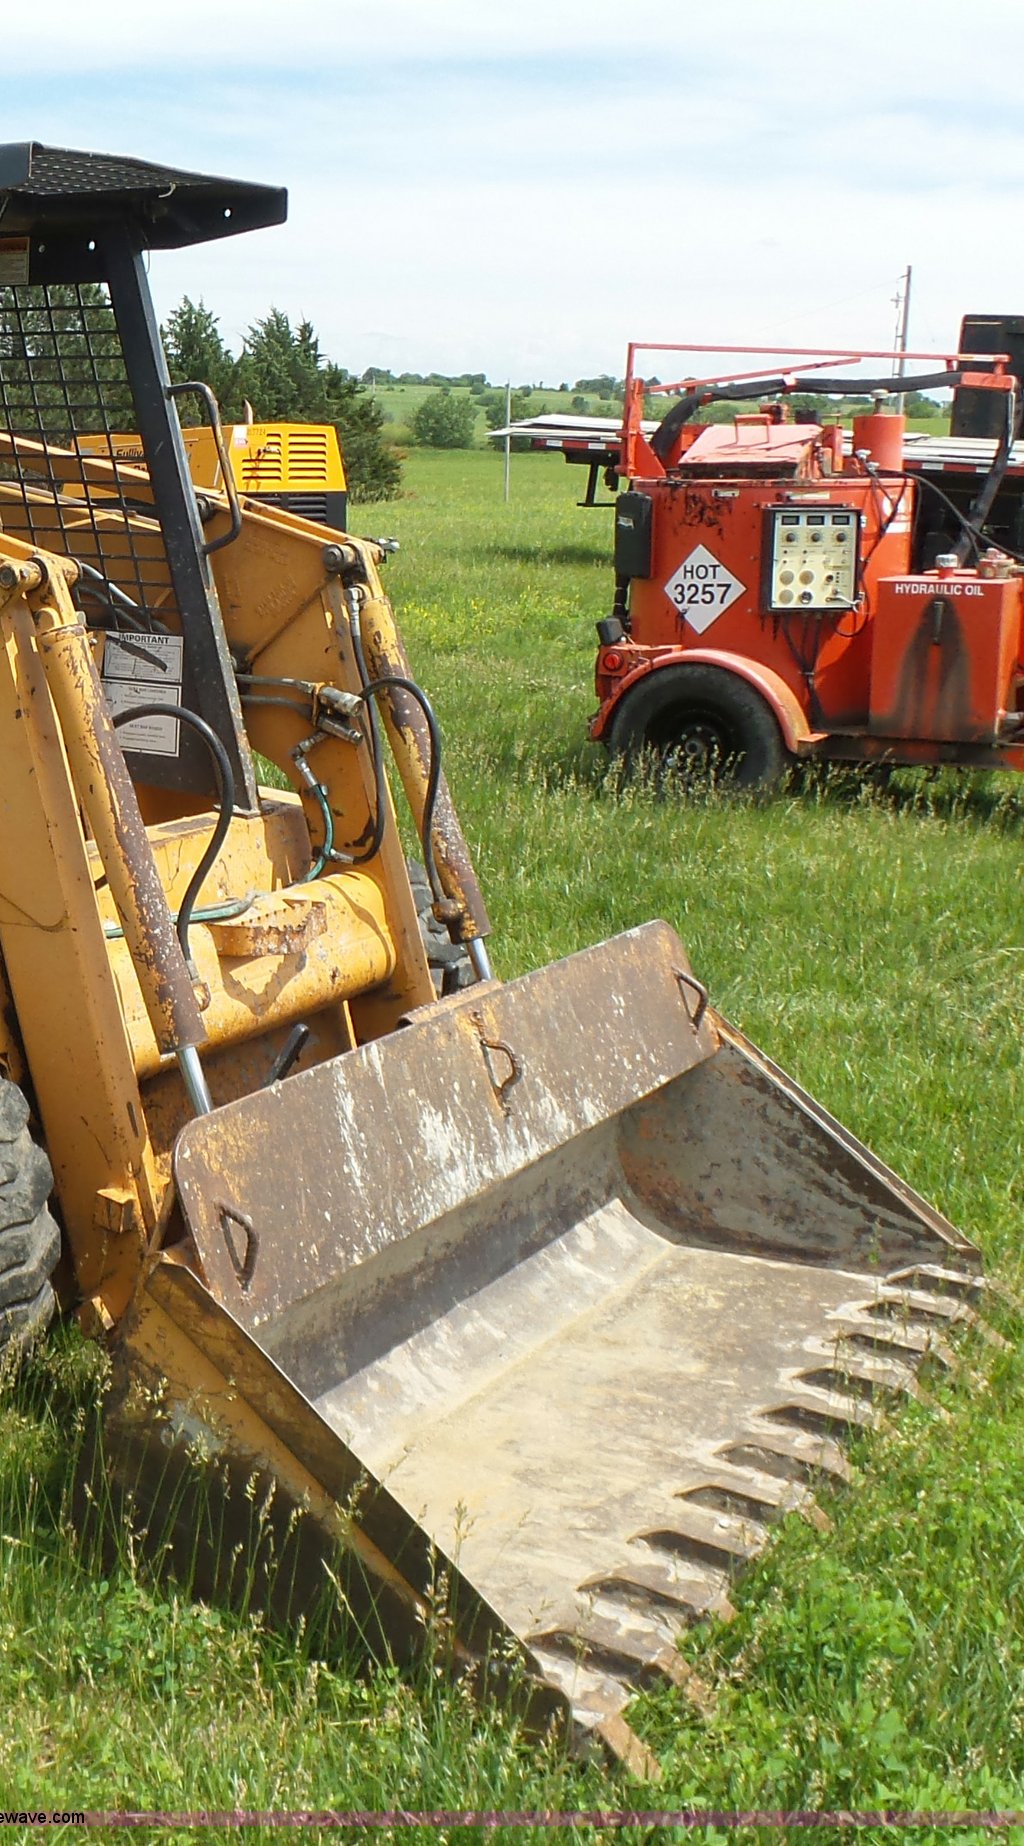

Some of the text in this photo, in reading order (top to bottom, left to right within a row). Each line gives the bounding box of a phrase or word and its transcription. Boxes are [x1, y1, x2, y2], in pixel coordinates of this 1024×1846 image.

[683, 564, 721, 580] HOT
[673, 583, 732, 605] 3257
[895, 583, 985, 597] HYDRAULIC OIL
[119, 634, 170, 644] IMPORTANT
